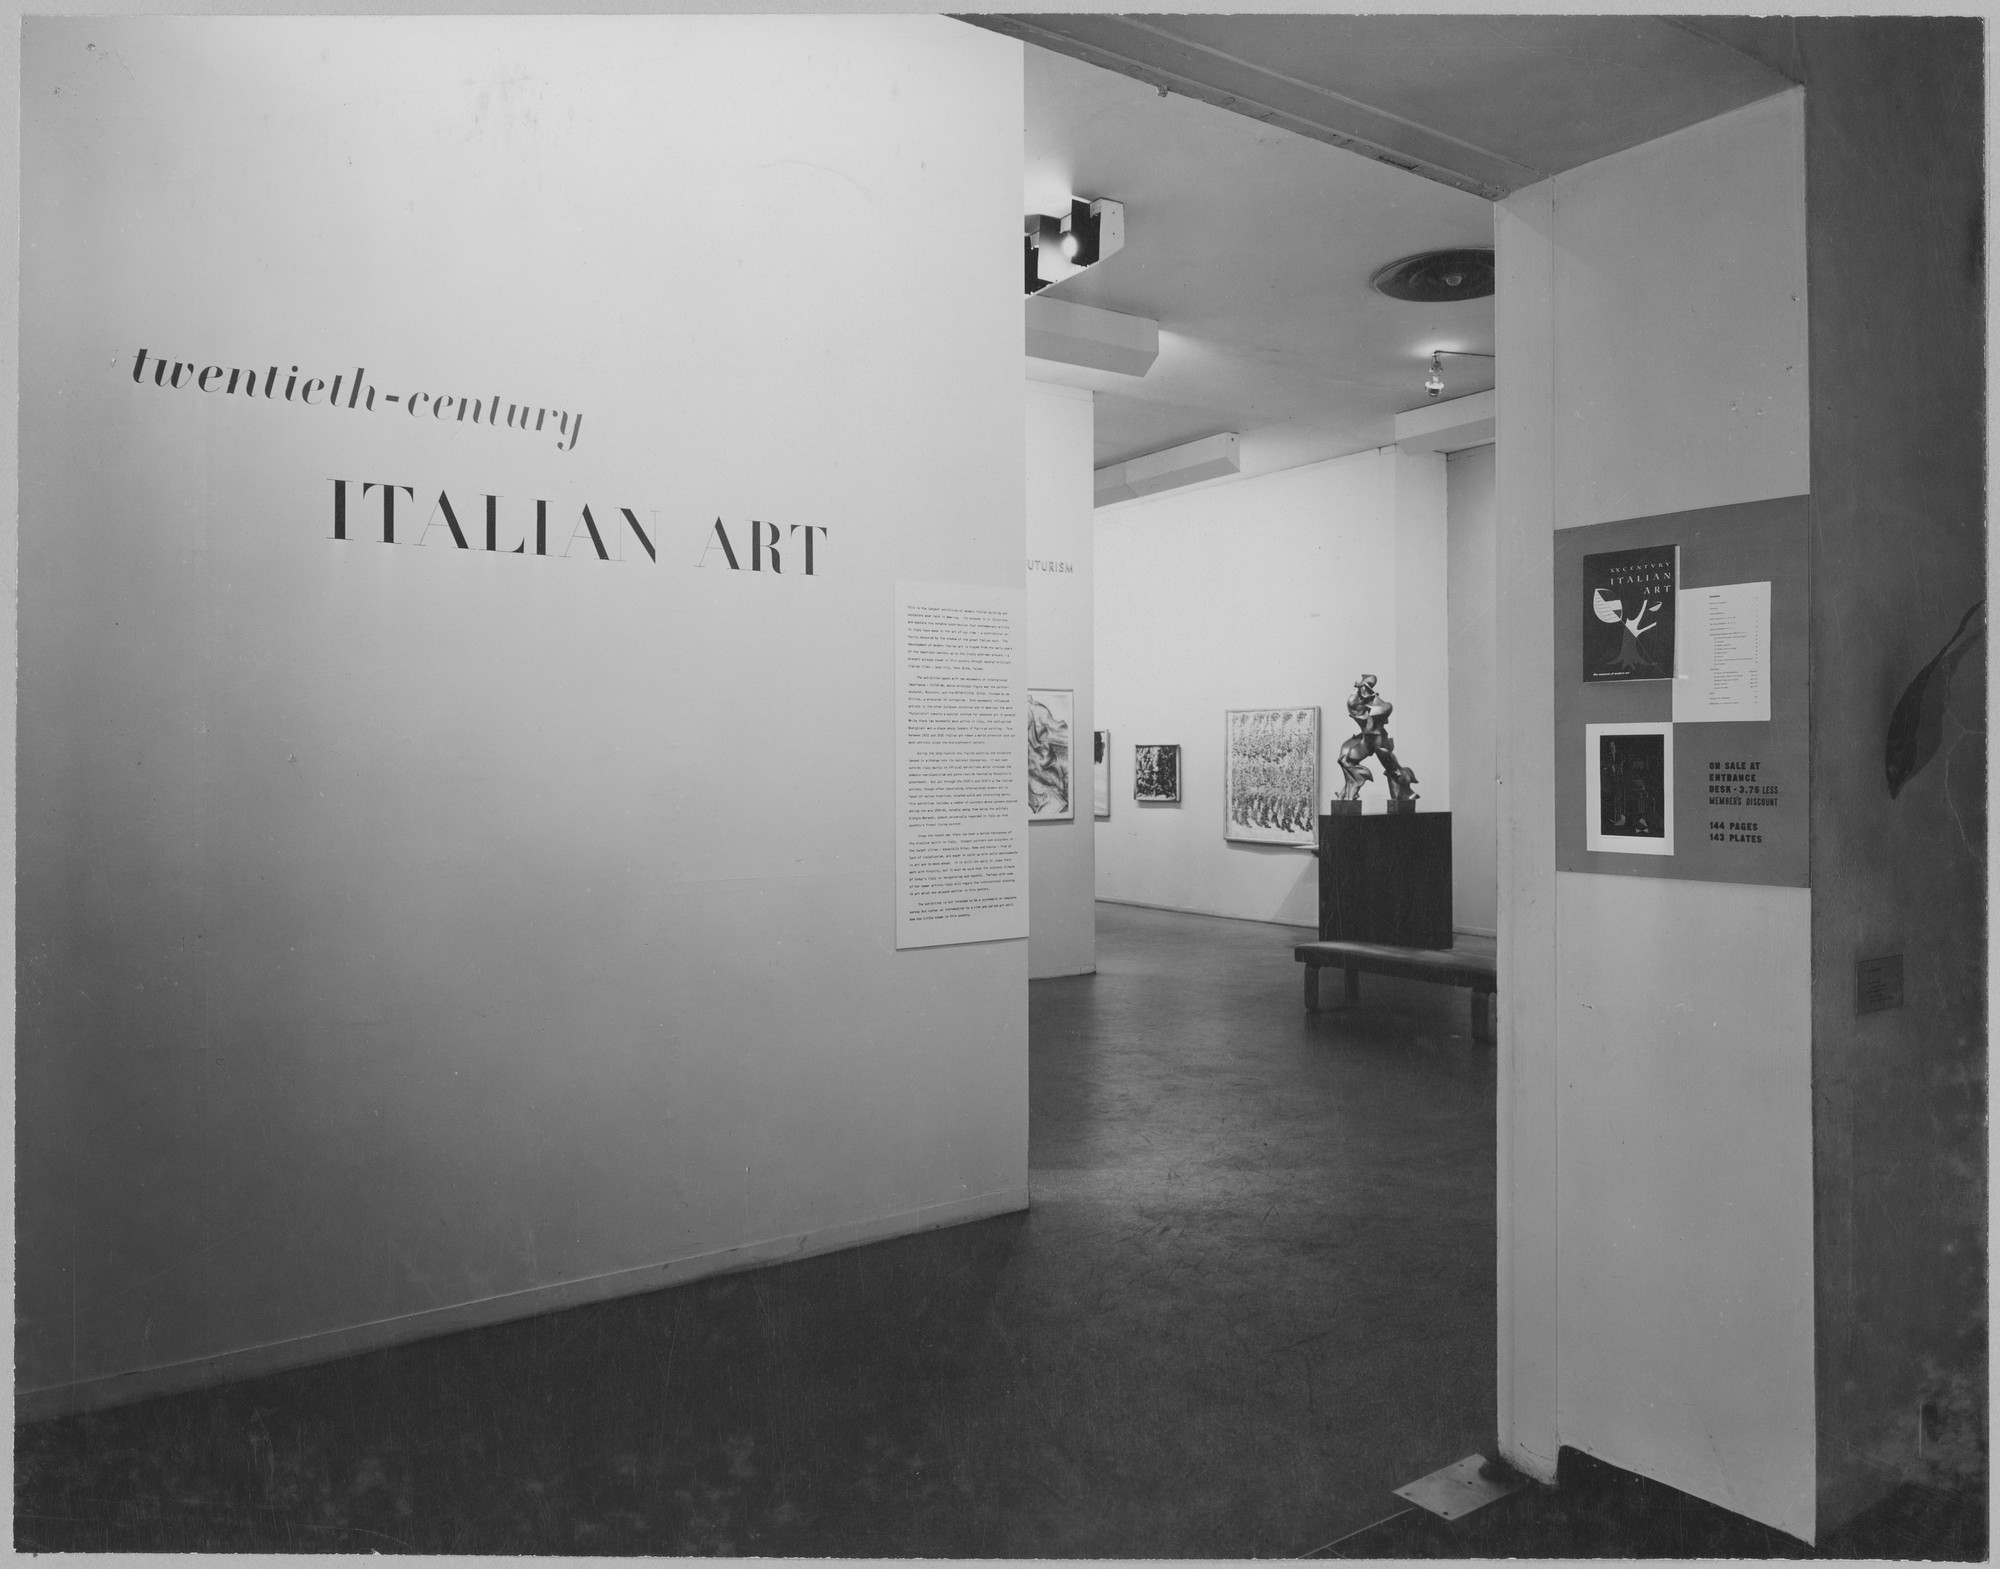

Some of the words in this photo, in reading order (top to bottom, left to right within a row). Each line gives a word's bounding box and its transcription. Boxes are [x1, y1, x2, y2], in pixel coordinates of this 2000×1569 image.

[131, 347, 583, 452] twentieth-century
[326, 478, 660, 564] ITALIAN
[694, 515, 828, 576] ART
[1610, 572, 1671, 586] ITALIAN
[1643, 585, 1671, 595] ART
[1709, 762, 1720, 770] ON
[1725, 762, 1746, 770] SALE
[1750, 762, 1760, 770] AT
[1709, 774, 1756, 782] ENTRANCE
[1709, 785, 1731, 793] DESK
[1739, 786, 1760, 794] 3.75
[1763, 786, 1778, 794] LESS
[1709, 796, 1742, 805] MEMBER'S
[1746, 798, 1778, 807] DISCOUNT
[1710, 822, 1725, 830] 144
[1730, 823, 1758, 831] PAGES
[1730, 834, 1762, 843] PLATES
